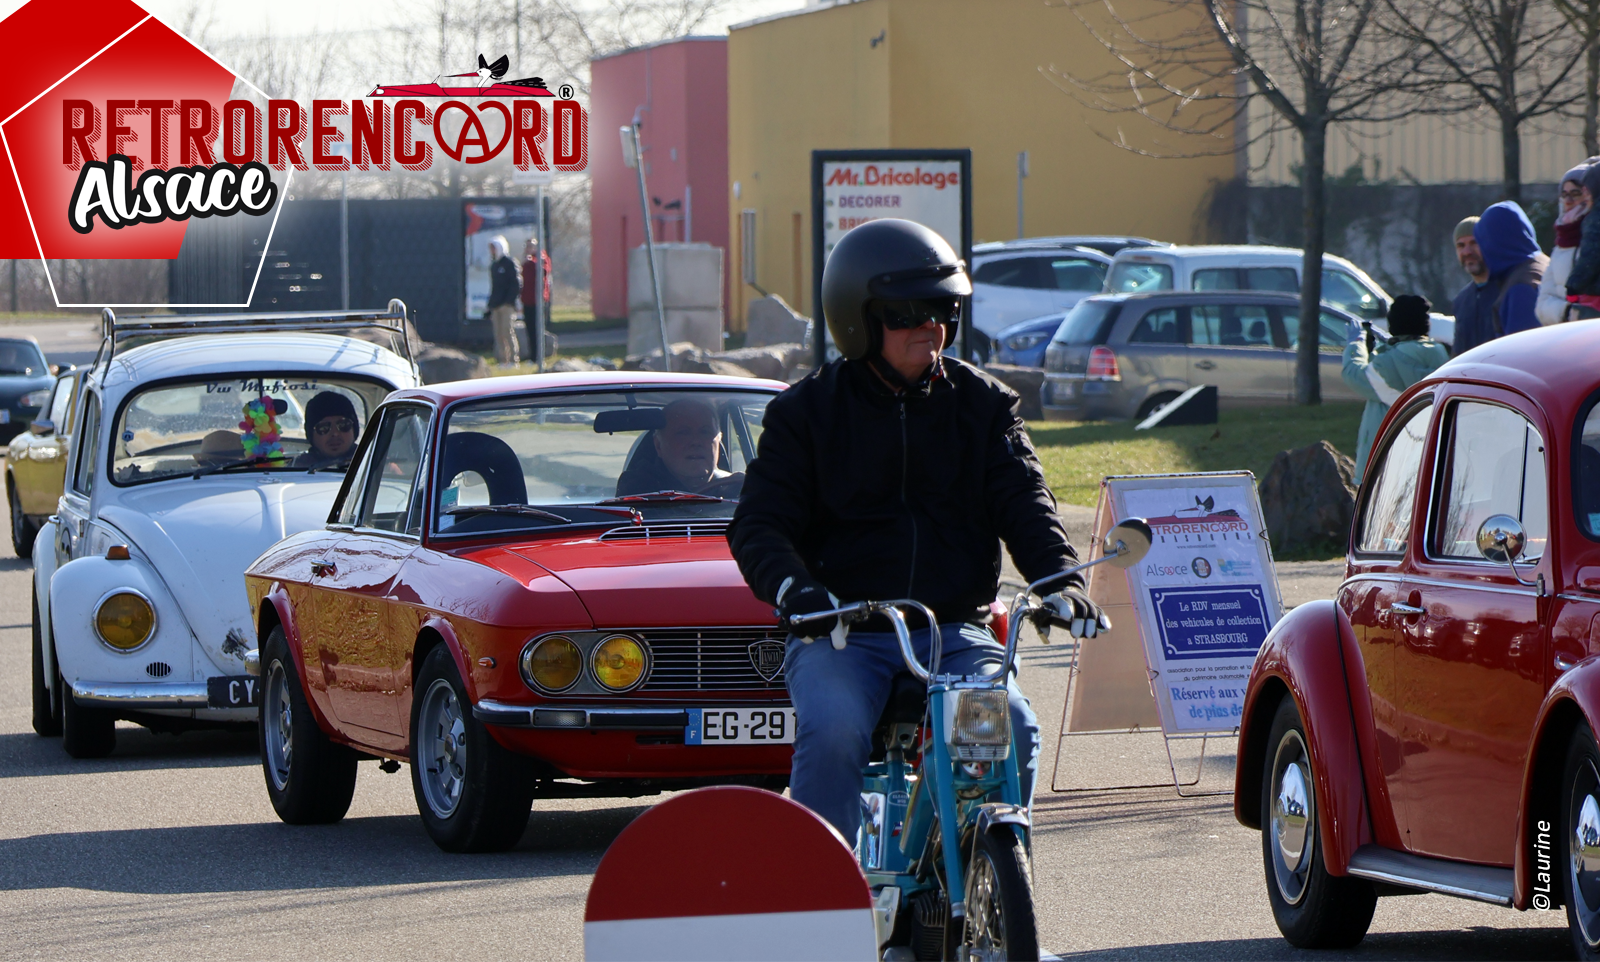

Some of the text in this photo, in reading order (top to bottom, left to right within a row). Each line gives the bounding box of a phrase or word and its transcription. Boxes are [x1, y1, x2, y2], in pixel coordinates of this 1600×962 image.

[839, 195, 901, 208] DECORER
[240, 379, 318, 394] Mafiosi
[1146, 563, 1188, 576] Alsace
[1179, 600, 1241, 612] Le RDV mensuel
[1166, 618, 1179, 628] des
[1216, 616, 1225, 626] de
[1227, 615, 1262, 626] collection
[1194, 633, 1248, 645] STRASBOURG
[1214, 664, 1239, 672] promotion
[228, 679, 259, 704] CY
[1171, 686, 1216, 700] Réservé
[1218, 688, 1239, 699] aux
[1188, 704, 1203, 718] de
[702, 711, 797, 740] EG-29
[690, 730, 697, 739] F
